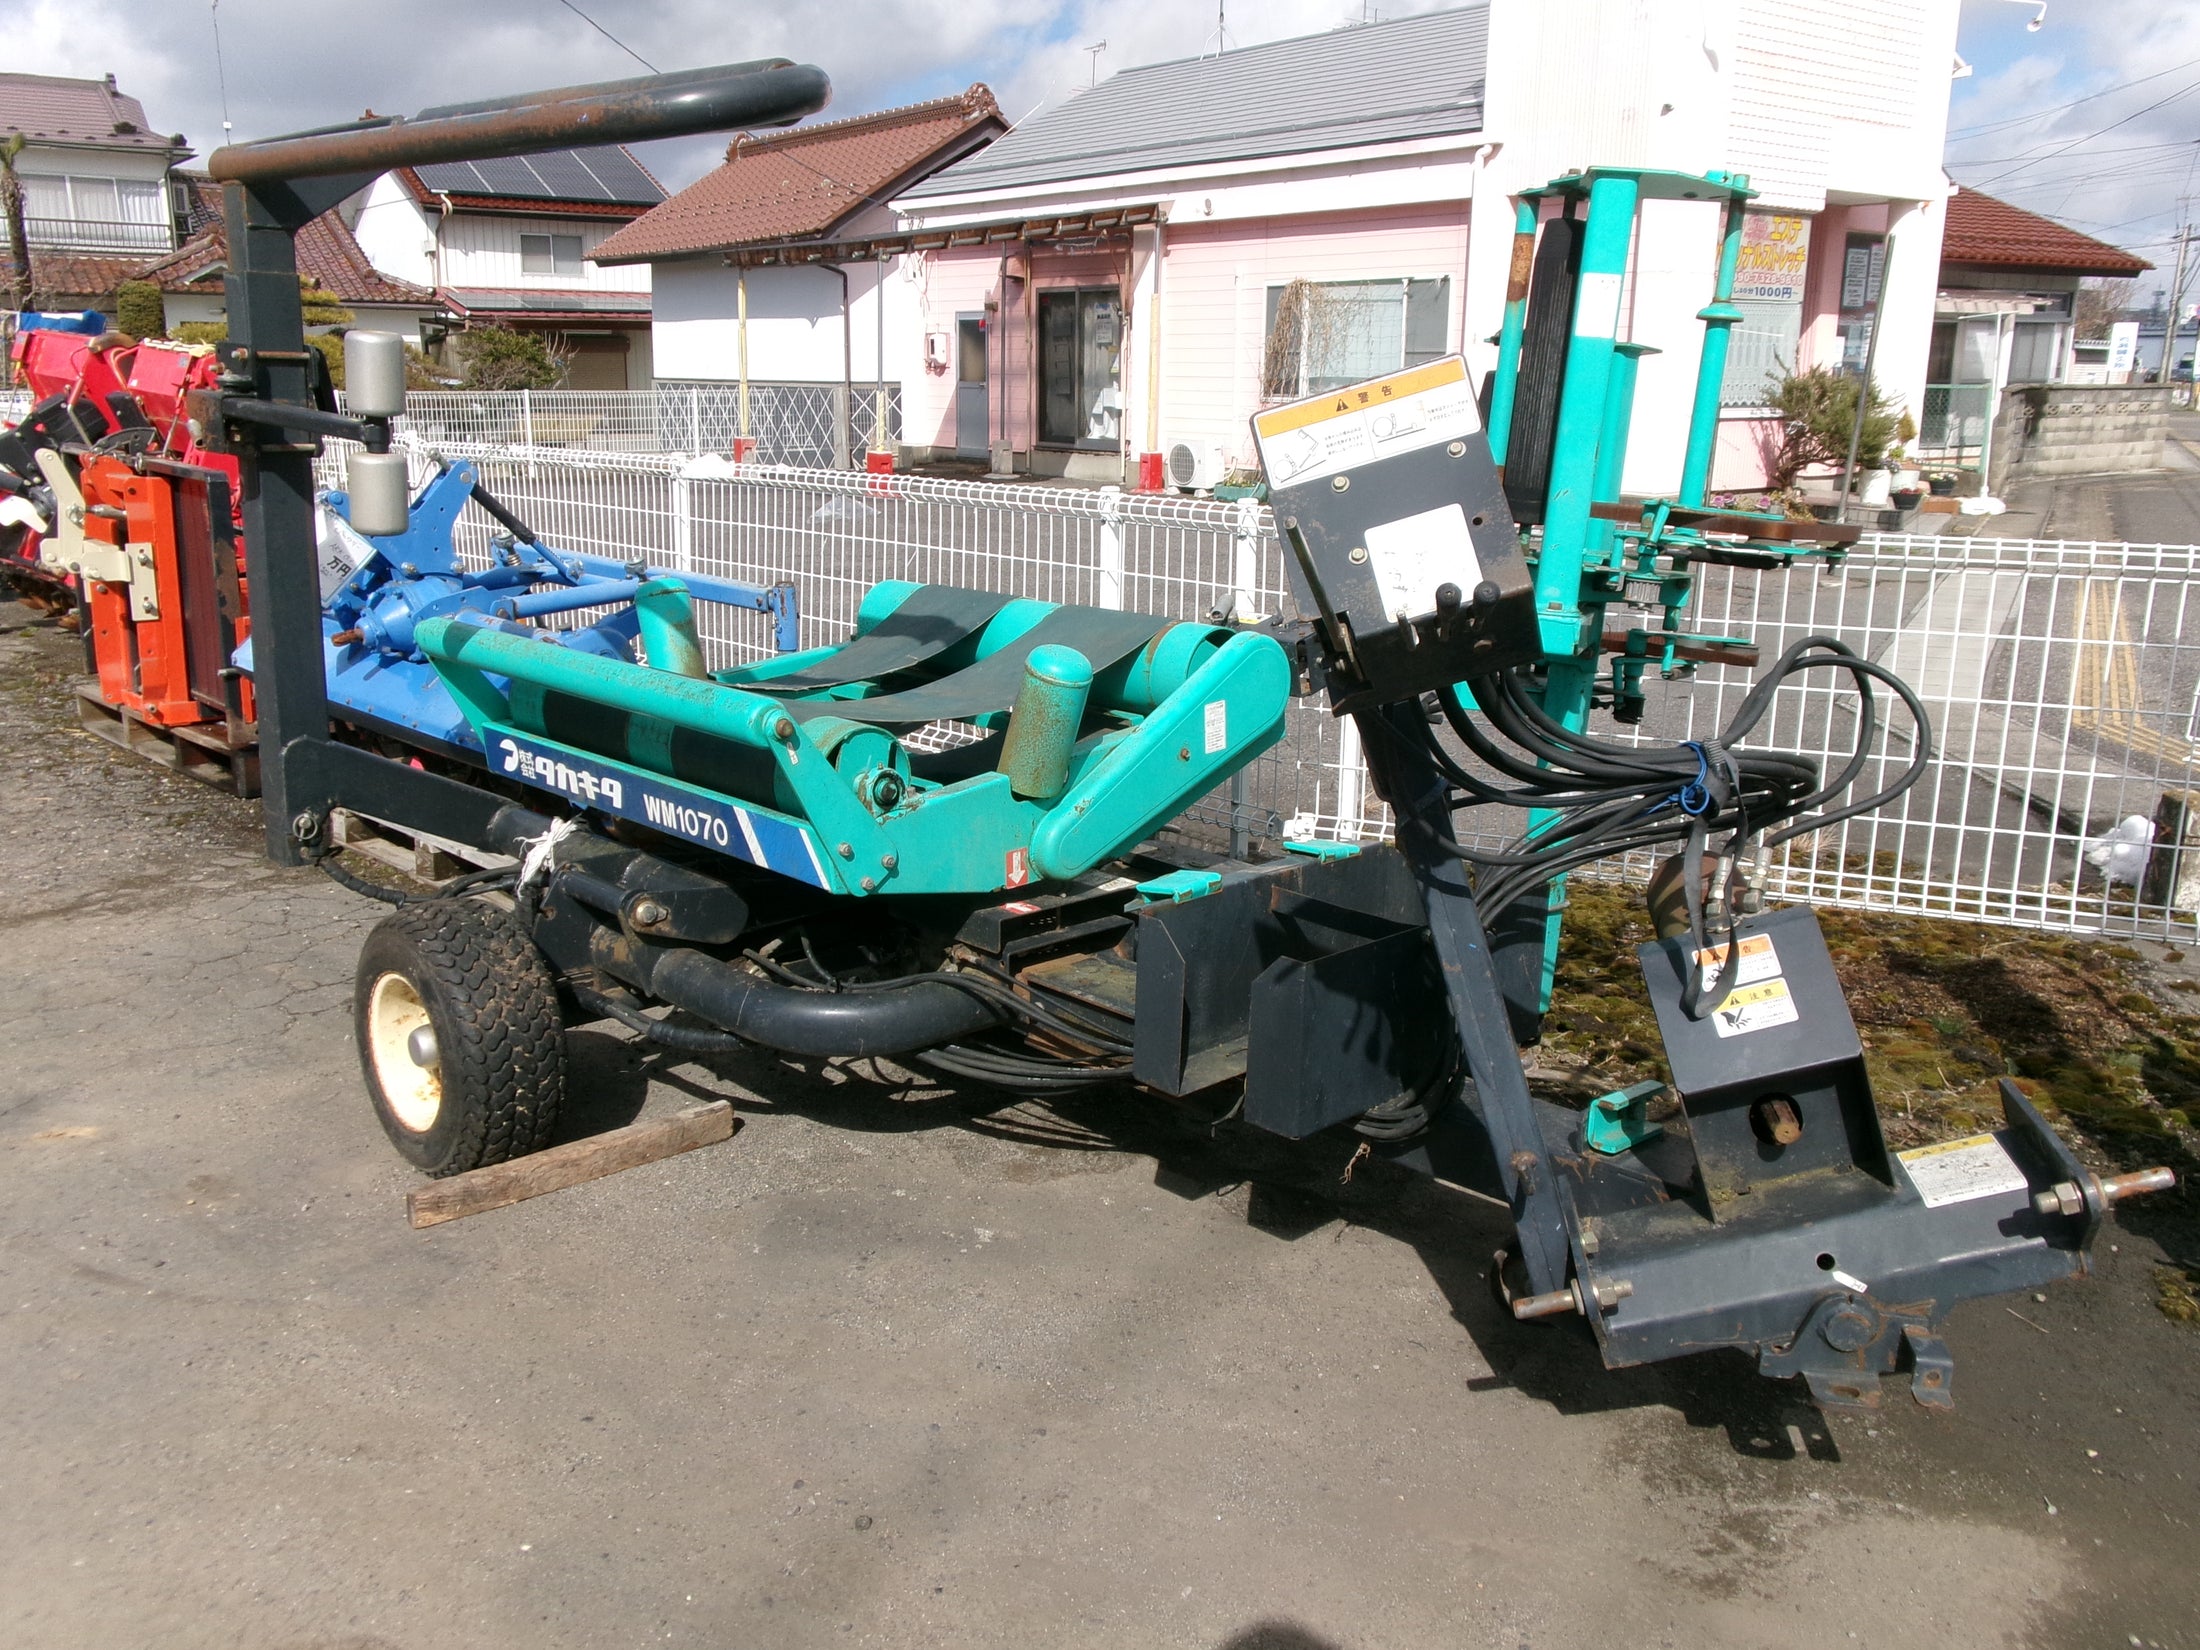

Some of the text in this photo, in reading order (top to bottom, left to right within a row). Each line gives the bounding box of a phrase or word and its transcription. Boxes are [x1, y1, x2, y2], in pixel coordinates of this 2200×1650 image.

[1770, 215, 1802, 244] エステ
[1734, 271, 1803, 286] 90-7328-9810
[1357, 385, 1393, 404] 警告
[327, 555, 352, 577] 万円
[535, 756, 622, 809] タカキタ
[643, 793, 728, 847] WM1070
